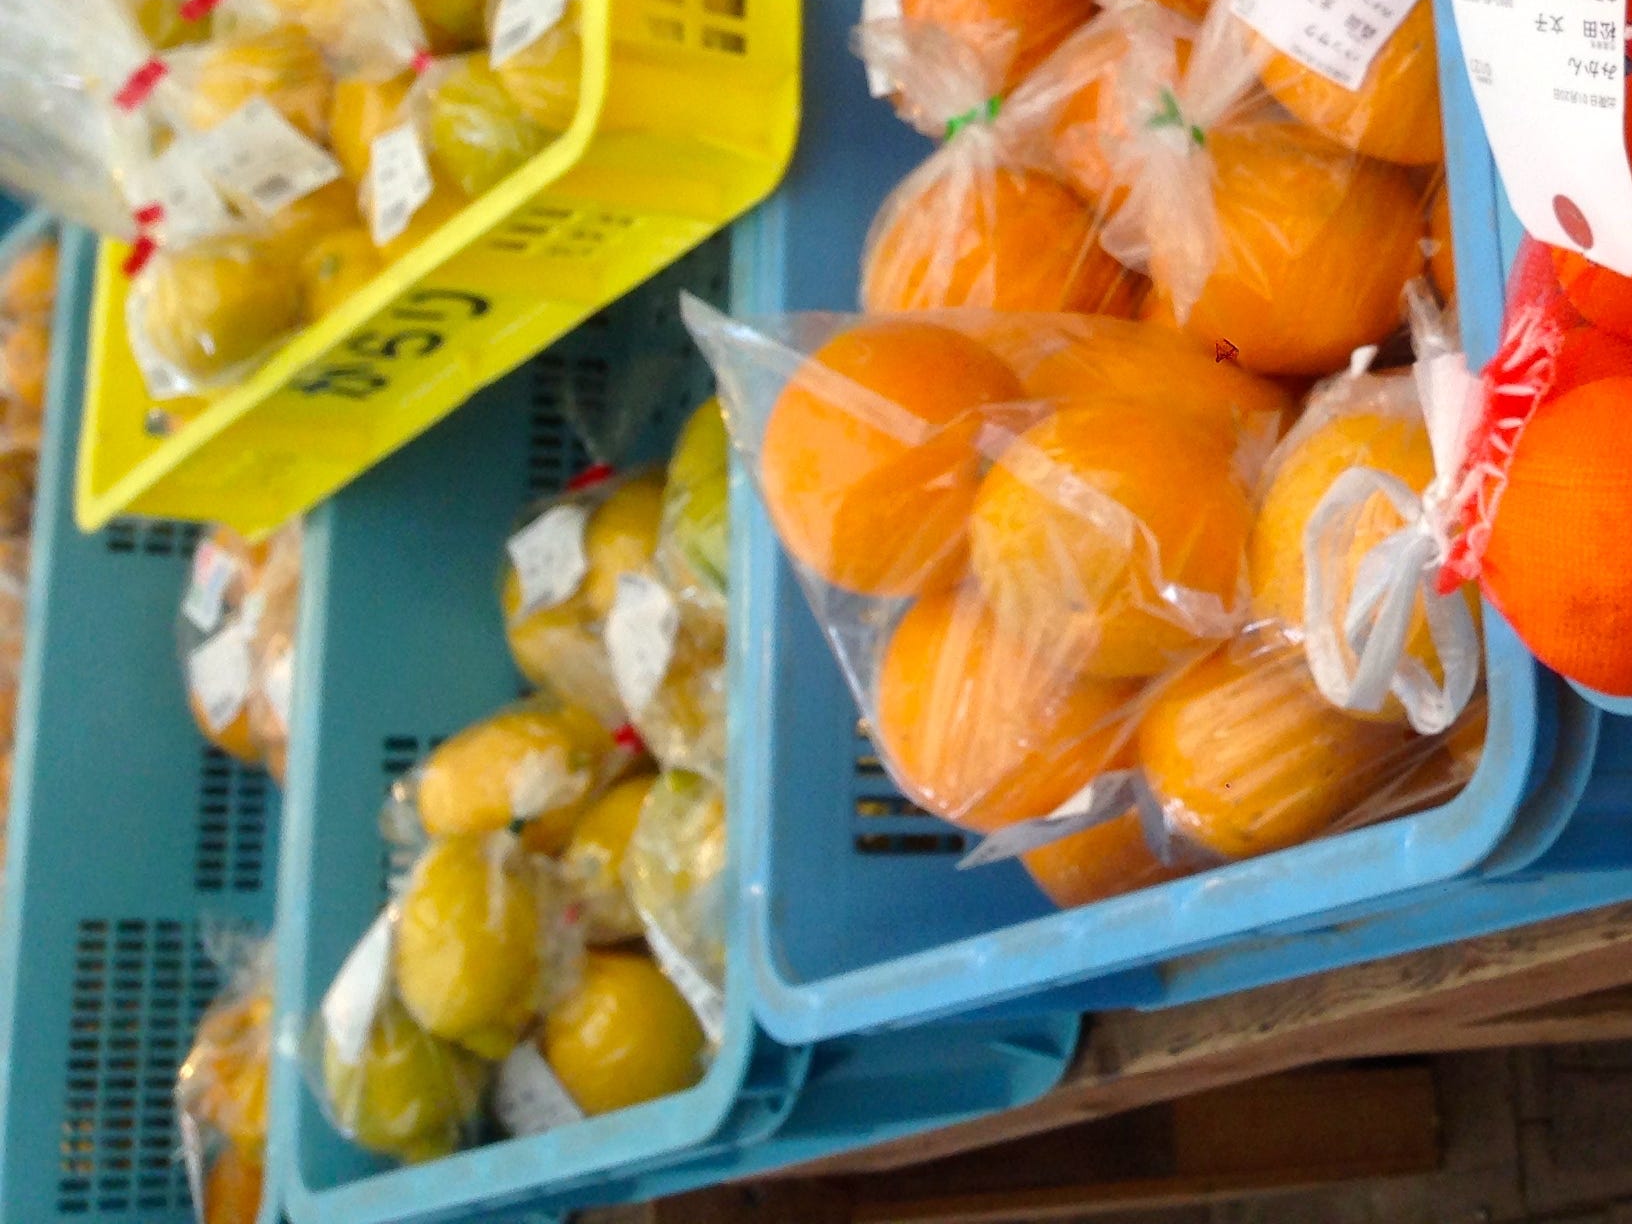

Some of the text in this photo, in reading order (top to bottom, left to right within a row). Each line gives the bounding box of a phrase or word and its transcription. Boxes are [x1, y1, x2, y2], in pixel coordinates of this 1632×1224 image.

[1534, 13, 1617, 40] 松田 文子
[1567, 56, 1618, 80] みかん
